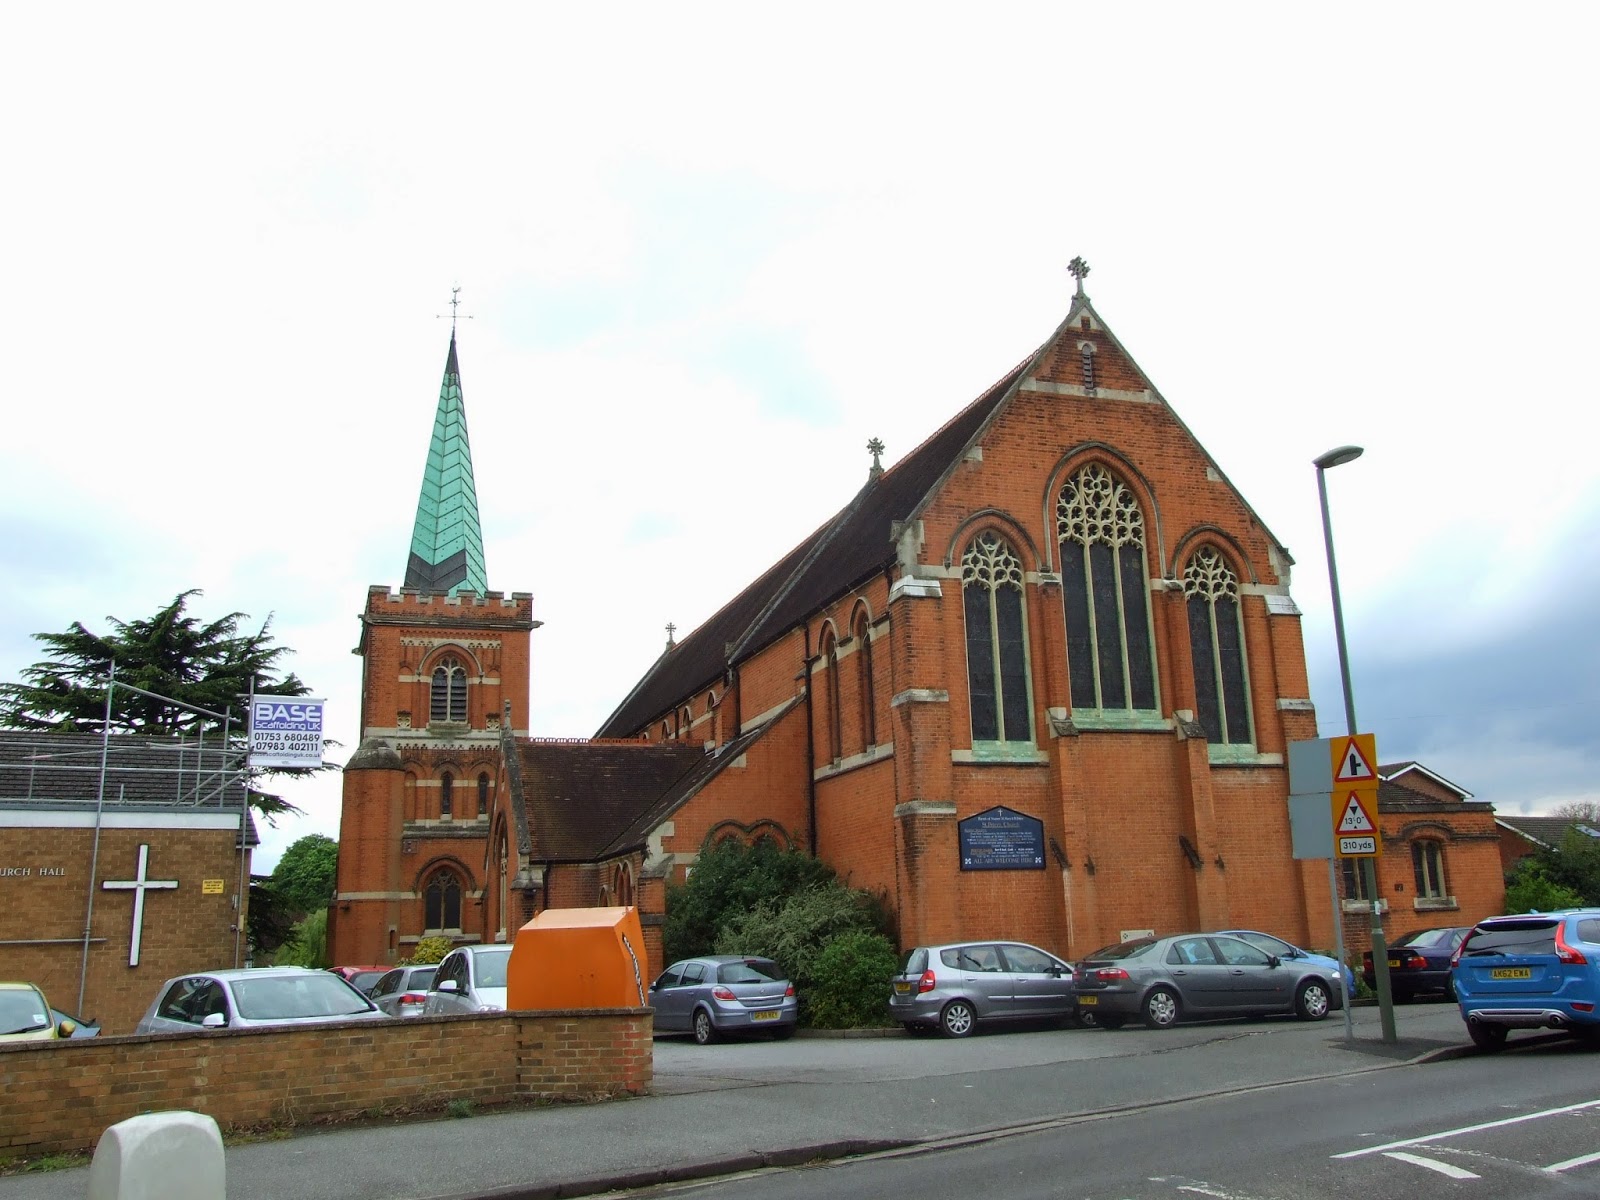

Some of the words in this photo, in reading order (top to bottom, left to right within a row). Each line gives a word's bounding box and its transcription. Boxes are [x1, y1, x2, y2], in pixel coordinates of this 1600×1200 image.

[255, 704, 321, 722] BASE
[255, 721, 306, 730] Scaffolding
[307, 722, 321, 730] UK
[254, 732, 281, 741] 01753
[284, 733, 320, 742] 680489
[255, 742, 285, 750] 07983
[288, 743, 318, 751] 402111
[1343, 841, 1357, 850] 310
[1358, 841, 1372, 850] yds
[39, 867, 66, 876] HALL
